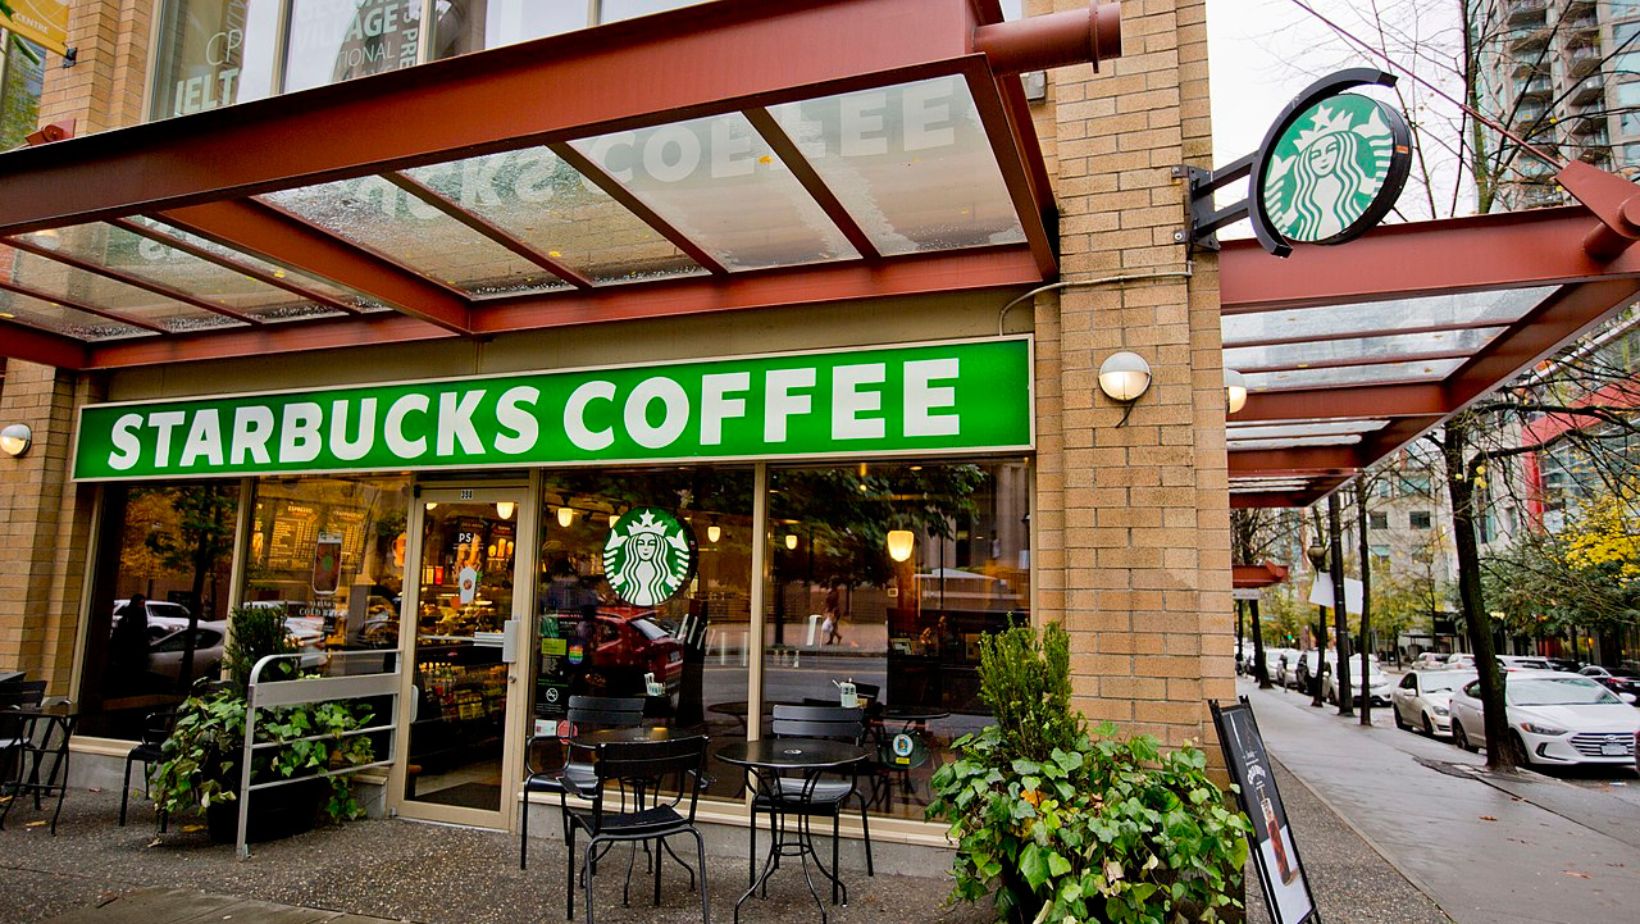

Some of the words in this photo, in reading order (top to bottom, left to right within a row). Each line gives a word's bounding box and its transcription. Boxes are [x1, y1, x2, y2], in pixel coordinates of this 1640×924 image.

[107, 385, 541, 470] STARBUCKS
[563, 357, 960, 451] COFFEE
[459, 532, 478, 543] PS
